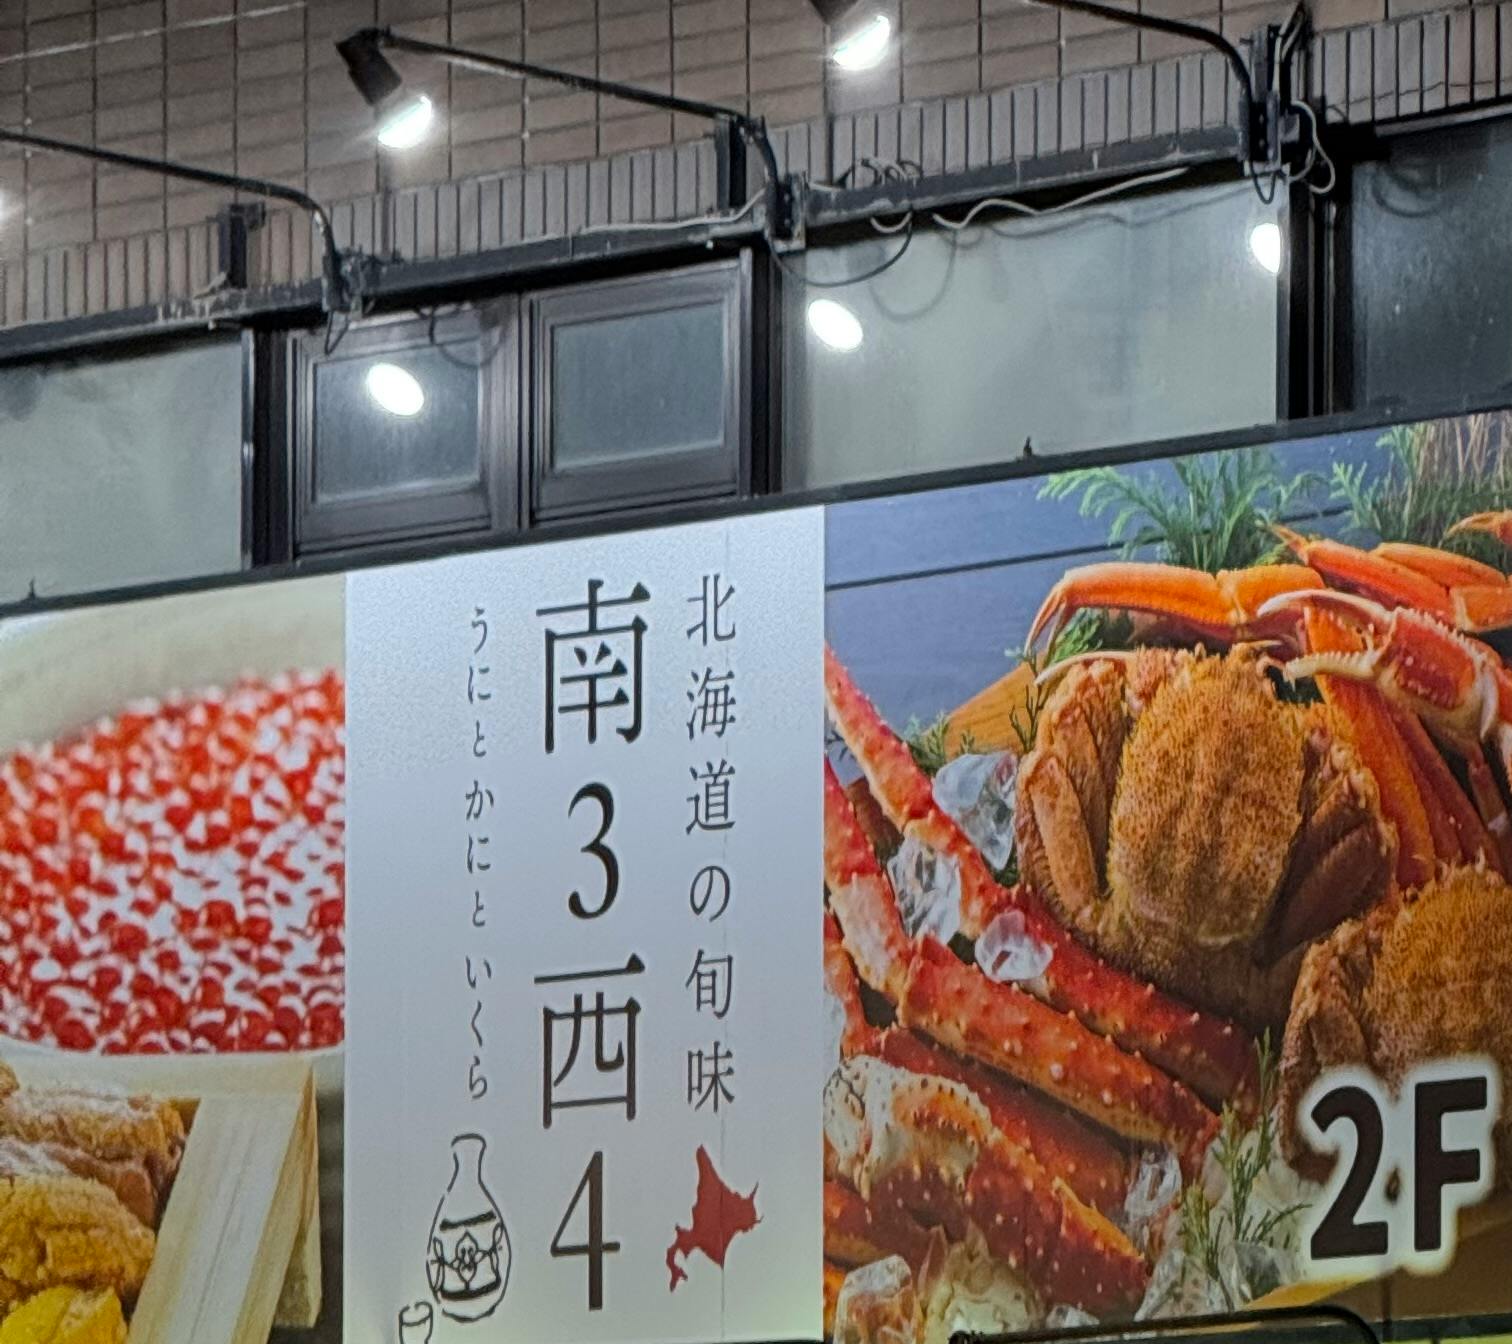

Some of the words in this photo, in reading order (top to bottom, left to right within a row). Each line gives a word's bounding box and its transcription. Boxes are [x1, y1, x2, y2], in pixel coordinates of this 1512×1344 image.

[465, 608, 493, 1099] うにとかにといくら
[534, 579, 650, 1310] 南3西4
[685, 574, 736, 1113] 北海道の旬味
[1309, 1074, 1488, 1261] 2F
